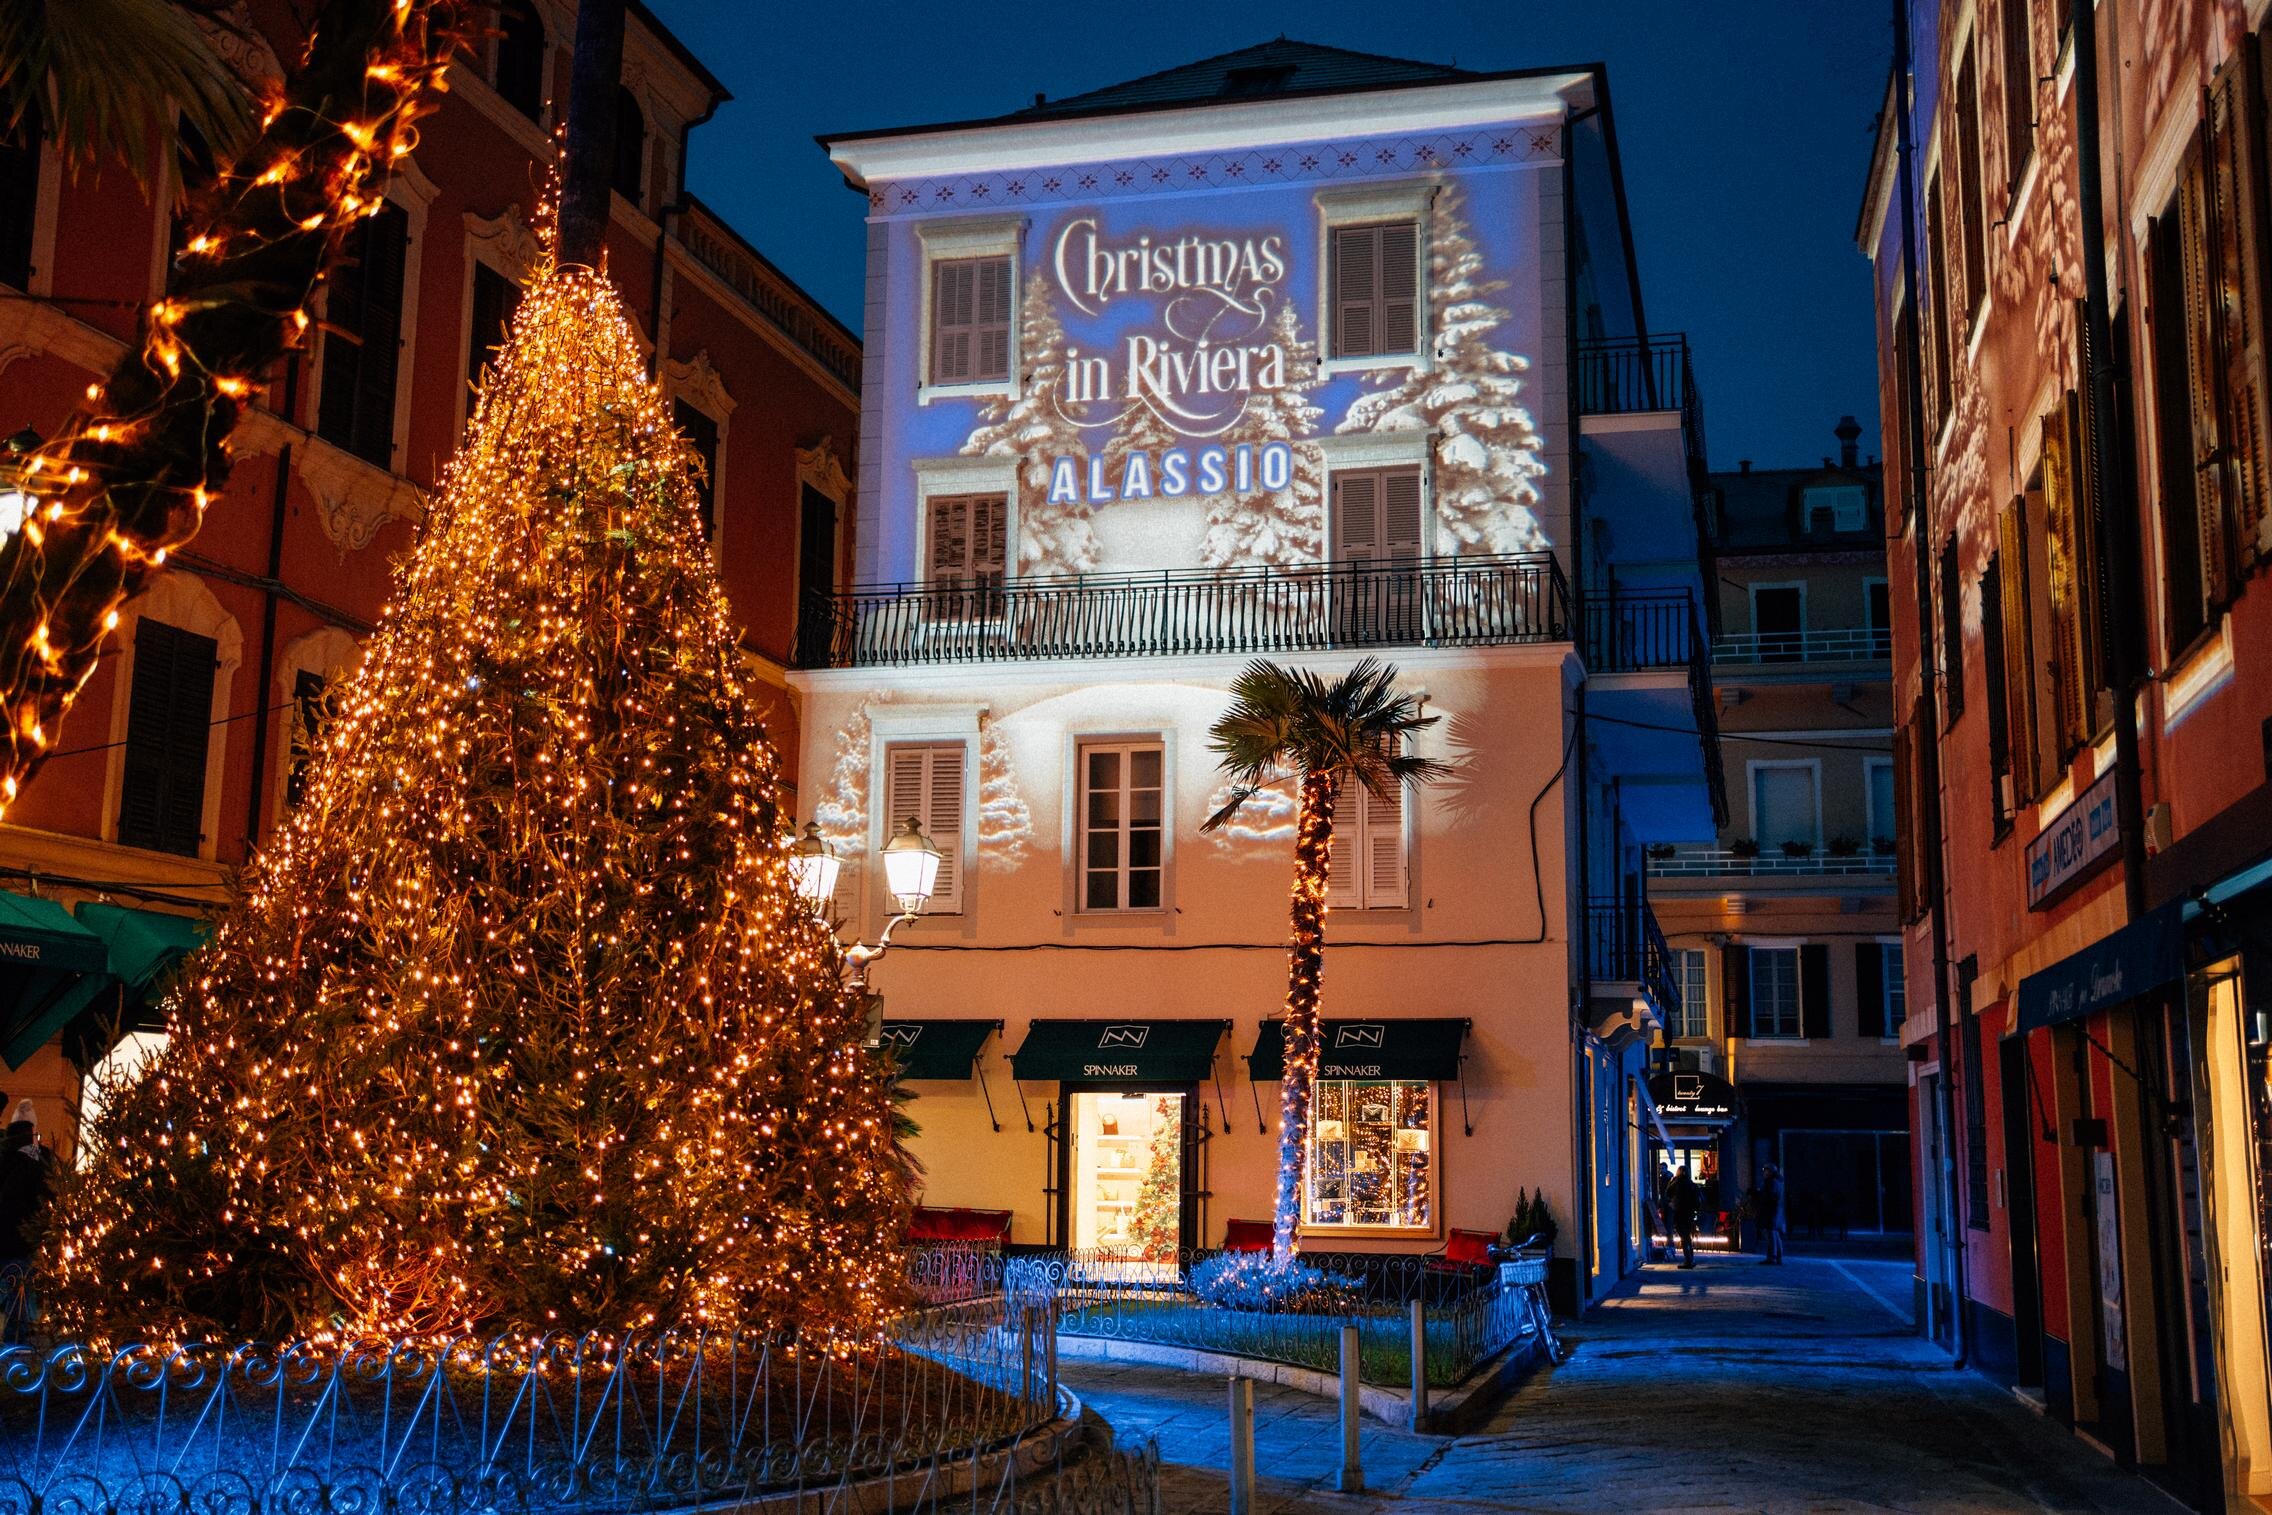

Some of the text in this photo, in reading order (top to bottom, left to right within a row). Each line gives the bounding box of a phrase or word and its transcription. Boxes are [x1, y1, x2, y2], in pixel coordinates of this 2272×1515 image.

[1066, 336, 1286, 420] in Riviera
[1050, 444, 1291, 503] ALASSIO
[1083, 1064, 1138, 1076] SPINNAKER
[1324, 1064, 1381, 1076] SPINNAKER
